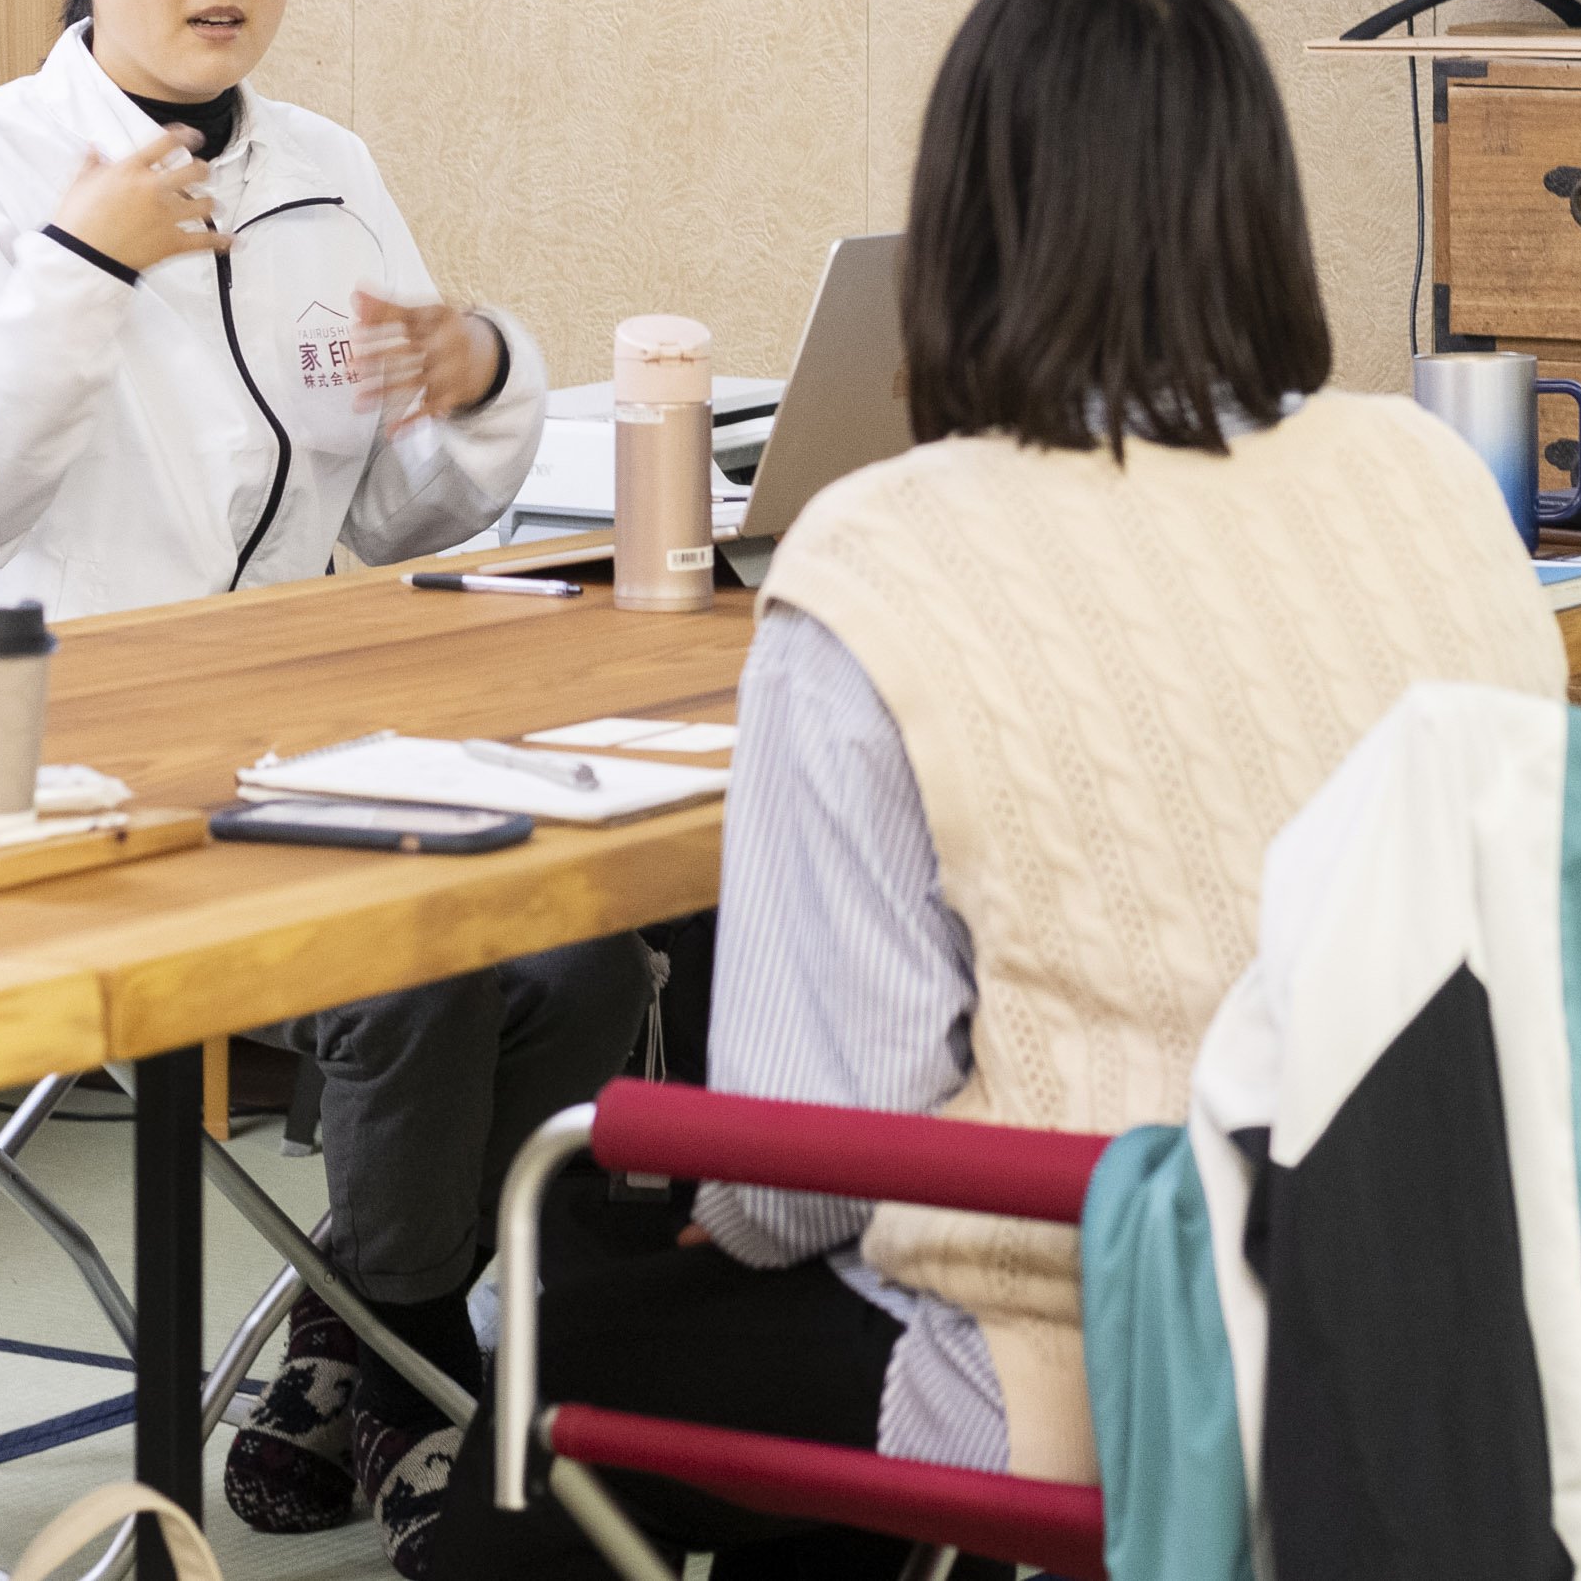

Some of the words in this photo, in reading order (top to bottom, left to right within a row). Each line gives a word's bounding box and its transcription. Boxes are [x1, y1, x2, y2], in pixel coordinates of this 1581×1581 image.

[298, 340, 355, 372] 家印
[303, 369, 362, 390] 株式会社
